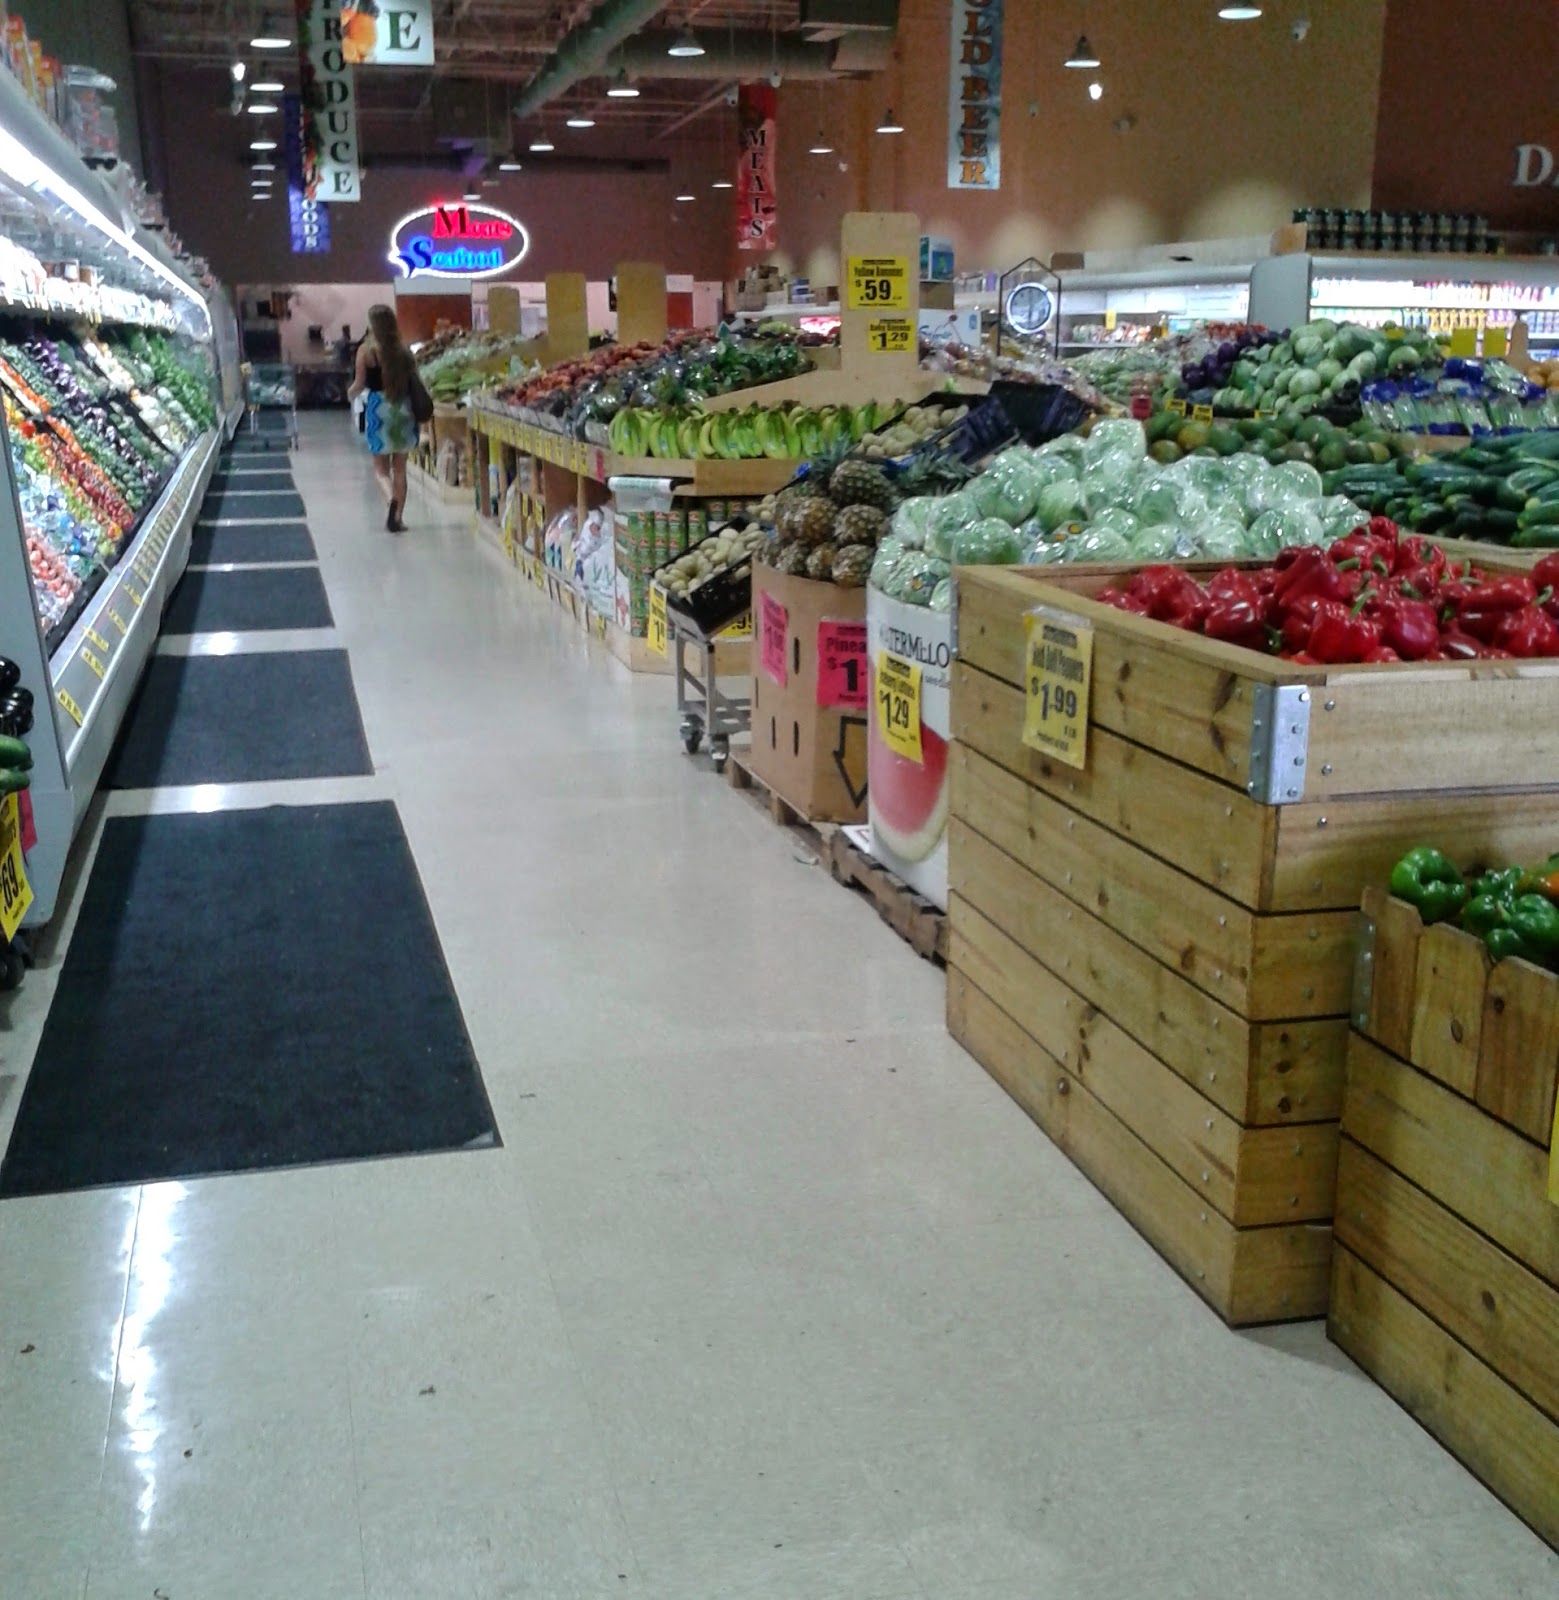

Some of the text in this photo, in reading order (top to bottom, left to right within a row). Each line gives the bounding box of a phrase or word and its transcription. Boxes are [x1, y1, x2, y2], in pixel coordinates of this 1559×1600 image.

[386, 10, 421, 50] E
[749, 129, 767, 237] MEATS
[1513, 144, 1559, 187] D
[408, 236, 503, 269] Seafood
